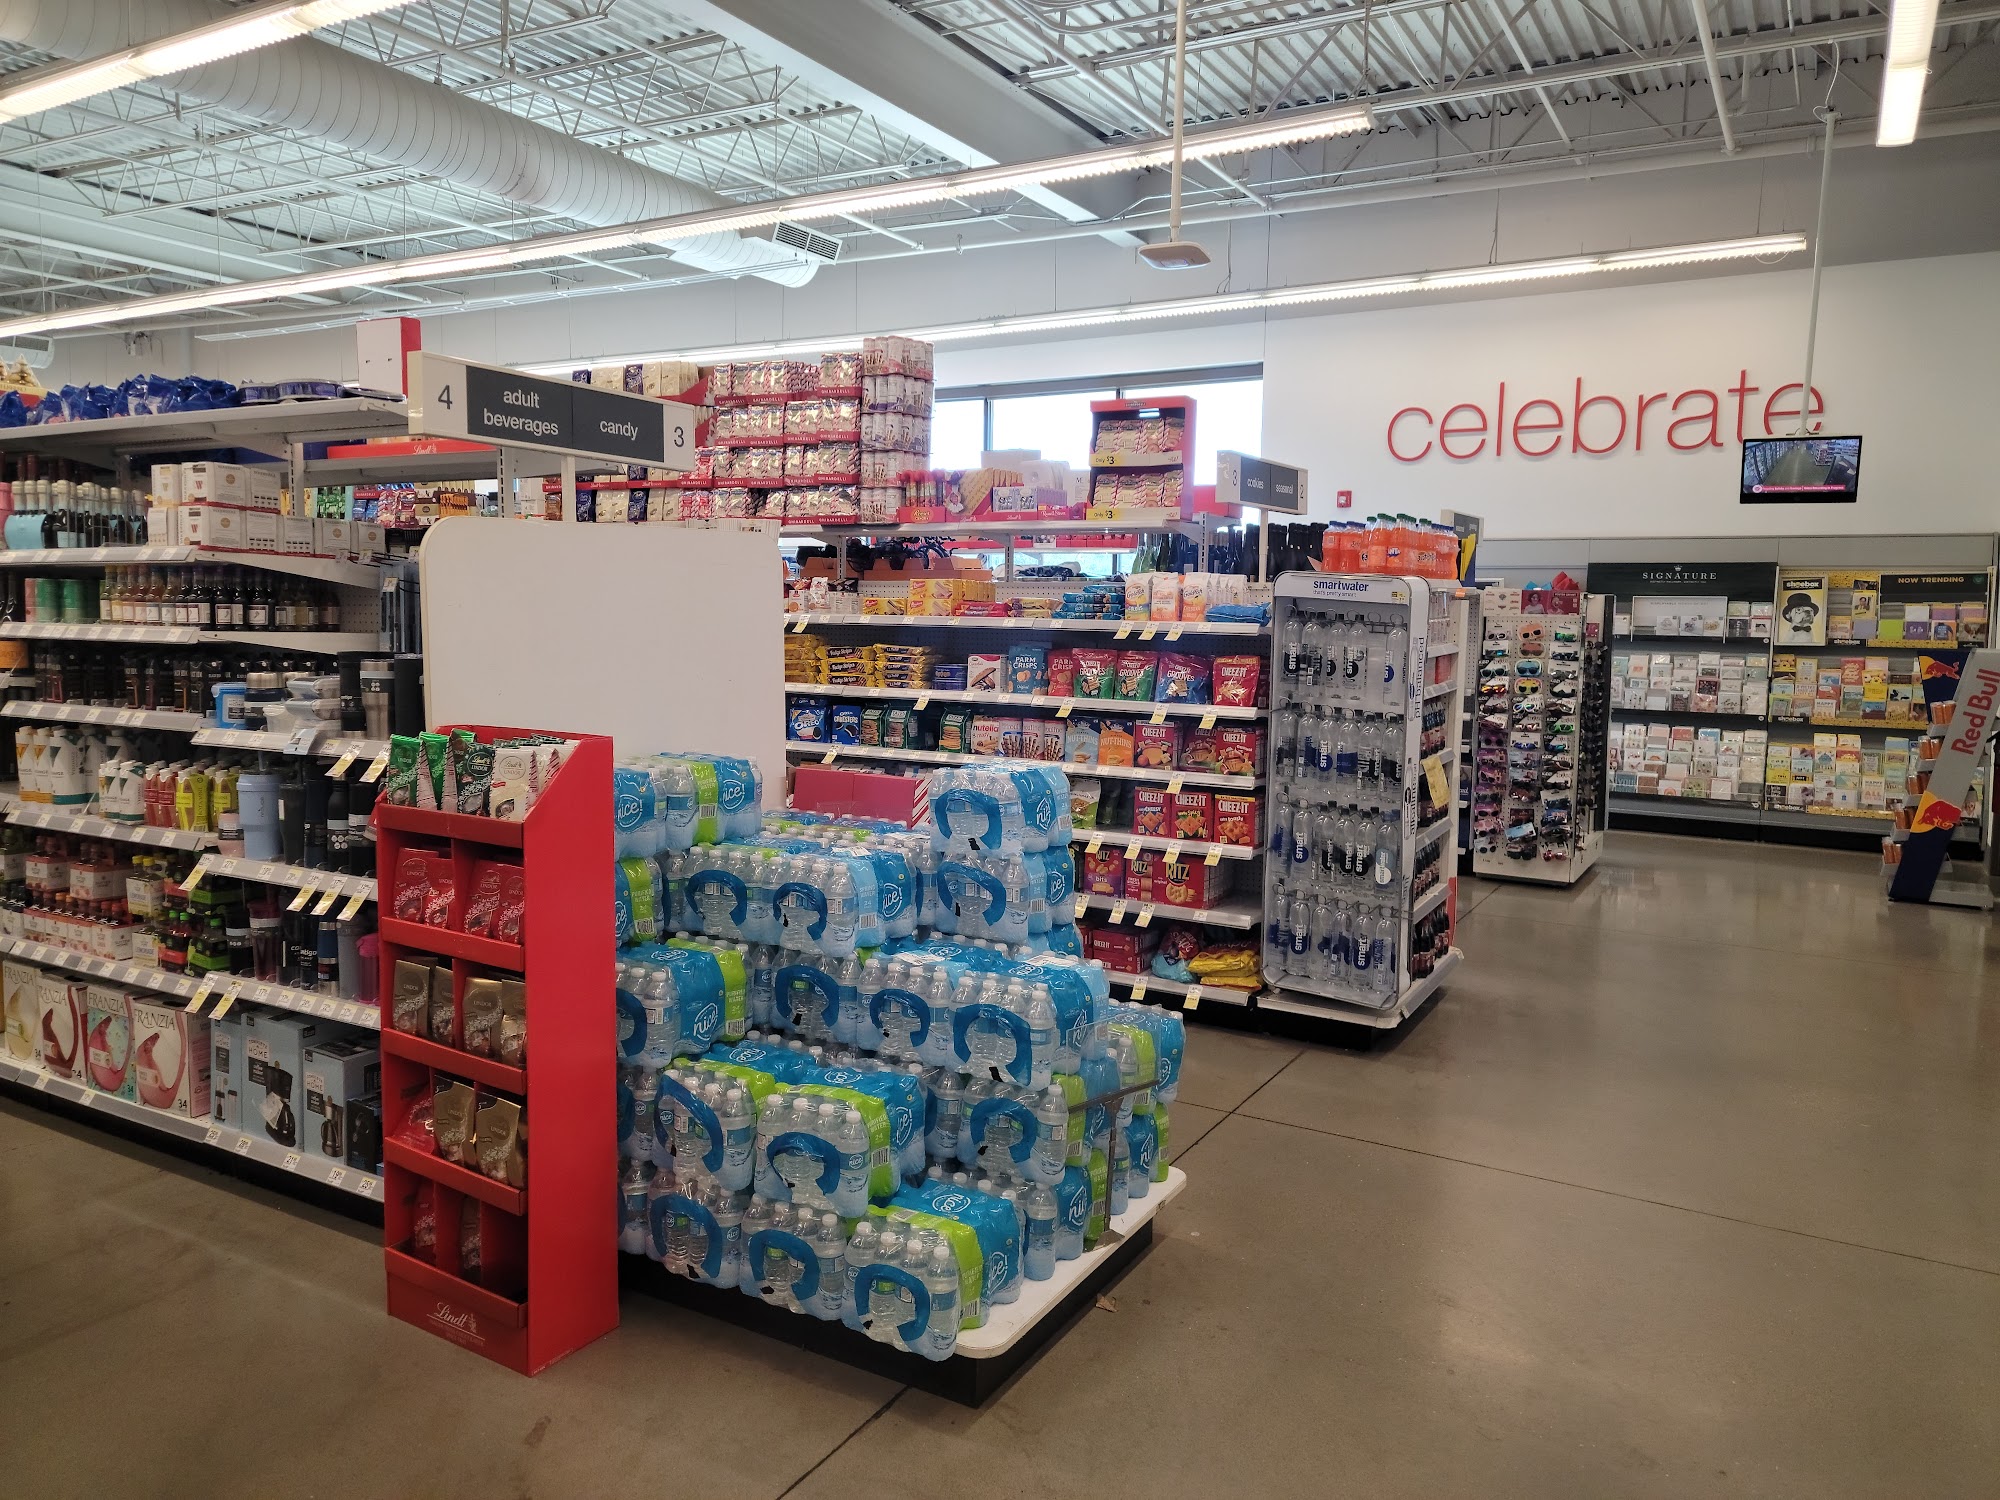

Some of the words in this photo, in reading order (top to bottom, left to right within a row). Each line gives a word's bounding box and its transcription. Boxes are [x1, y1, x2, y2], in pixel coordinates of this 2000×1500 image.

[438, 385, 452, 410] 4
[503, 389, 540, 409] adult
[1387, 369, 1825, 462] celebrate
[484, 408, 559, 437] beverages
[599, 419, 638, 441] candy
[673, 426, 685, 448] 3
[413, 444, 431, 455] Lindt
[1247, 477, 1264, 490] cookies
[1275, 483, 1294, 495] seasonal
[1642, 571, 1717, 581] SIGNATURE
[1921, 576, 1965, 584] TRENDING
[1313, 580, 1369, 592] smartwater
[1786, 580, 1820, 588] shoebox
[1289, 642, 1298, 670] smart
[1079, 668, 1106, 676] GROOVES
[1119, 668, 1144, 677] GROOVES
[1222, 666, 1247, 677] CHEEZ-IT
[1414, 637, 1425, 697] balanced
[1167, 669, 1195, 682] GROOVES
[1968, 668, 2000, 712] Bull
[794, 719, 820, 730] OREO
[973, 724, 999, 733] nutella
[1066, 734, 1098, 744] NUT-THINS
[1142, 727, 1167, 738] CHEEZ-IT
[1223, 732, 1247, 743] CHEEZ-IT
[1951, 711, 1986, 755] Red
[1100, 736, 1132, 749] NUT-THINS
[1320, 740, 1328, 768] smart
[722, 784, 746, 802] nice!
[1139, 790, 1165, 804] CHEEZ-IT
[1175, 794, 1207, 807] CHEEZ-IT
[1218, 799, 1250, 814] CHEEZ-IT
[1296, 832, 1304, 860] smart
[1096, 850, 1110, 861] RITZ
[1356, 844, 1364, 873] smart
[1131, 861, 1148, 873] RITZ
[1166, 863, 1189, 881] RITZ
[1295, 924, 1304, 951] smart
[1357, 936, 1367, 966] smart
[4, 965, 35, 986] FRANZIA
[38, 985, 68, 1007] RANZIA
[88, 992, 126, 1014] FRANZIA
[134, 1008, 176, 1031] FRANZIA
[35, 1048, 42, 1058] 34
[249, 1047, 268, 1059] HOME
[127, 1084, 135, 1094] 34
[306, 1080, 324, 1092] HOME
[178, 1098, 188, 1109] 34
[870, 1121, 887, 1133] WATER
[436, 1301, 469, 1329] Lindt
